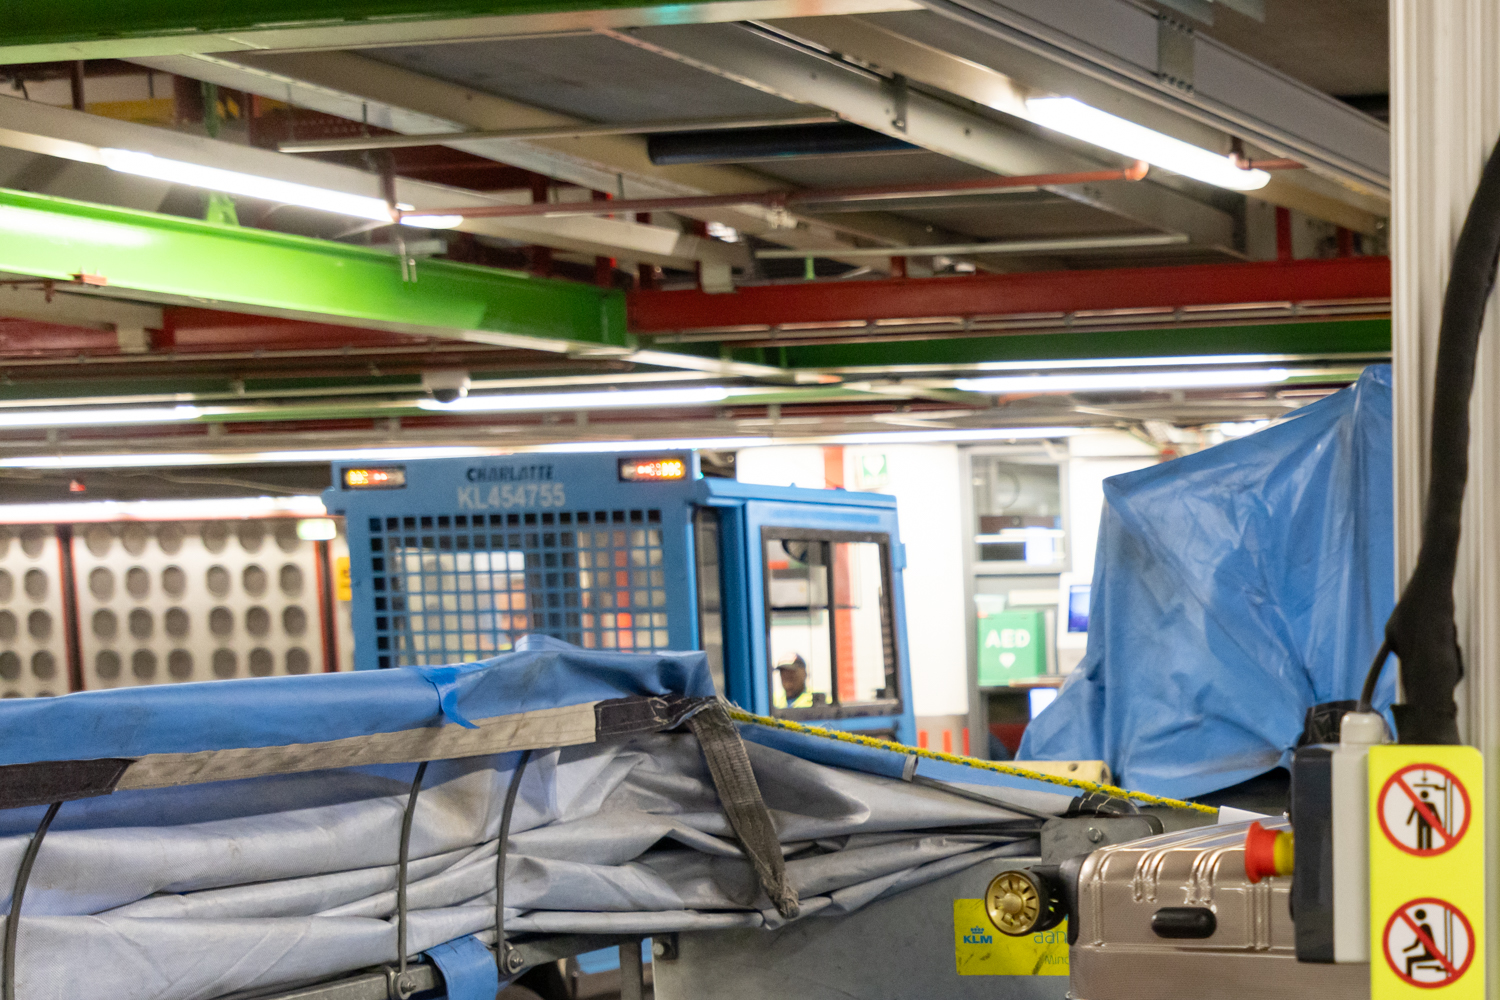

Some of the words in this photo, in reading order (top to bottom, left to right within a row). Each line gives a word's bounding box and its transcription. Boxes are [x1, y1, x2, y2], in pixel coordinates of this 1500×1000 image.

[458, 482, 565, 510] KL454755
[985, 629, 1031, 648] AED
[963, 935, 993, 945] KLM
